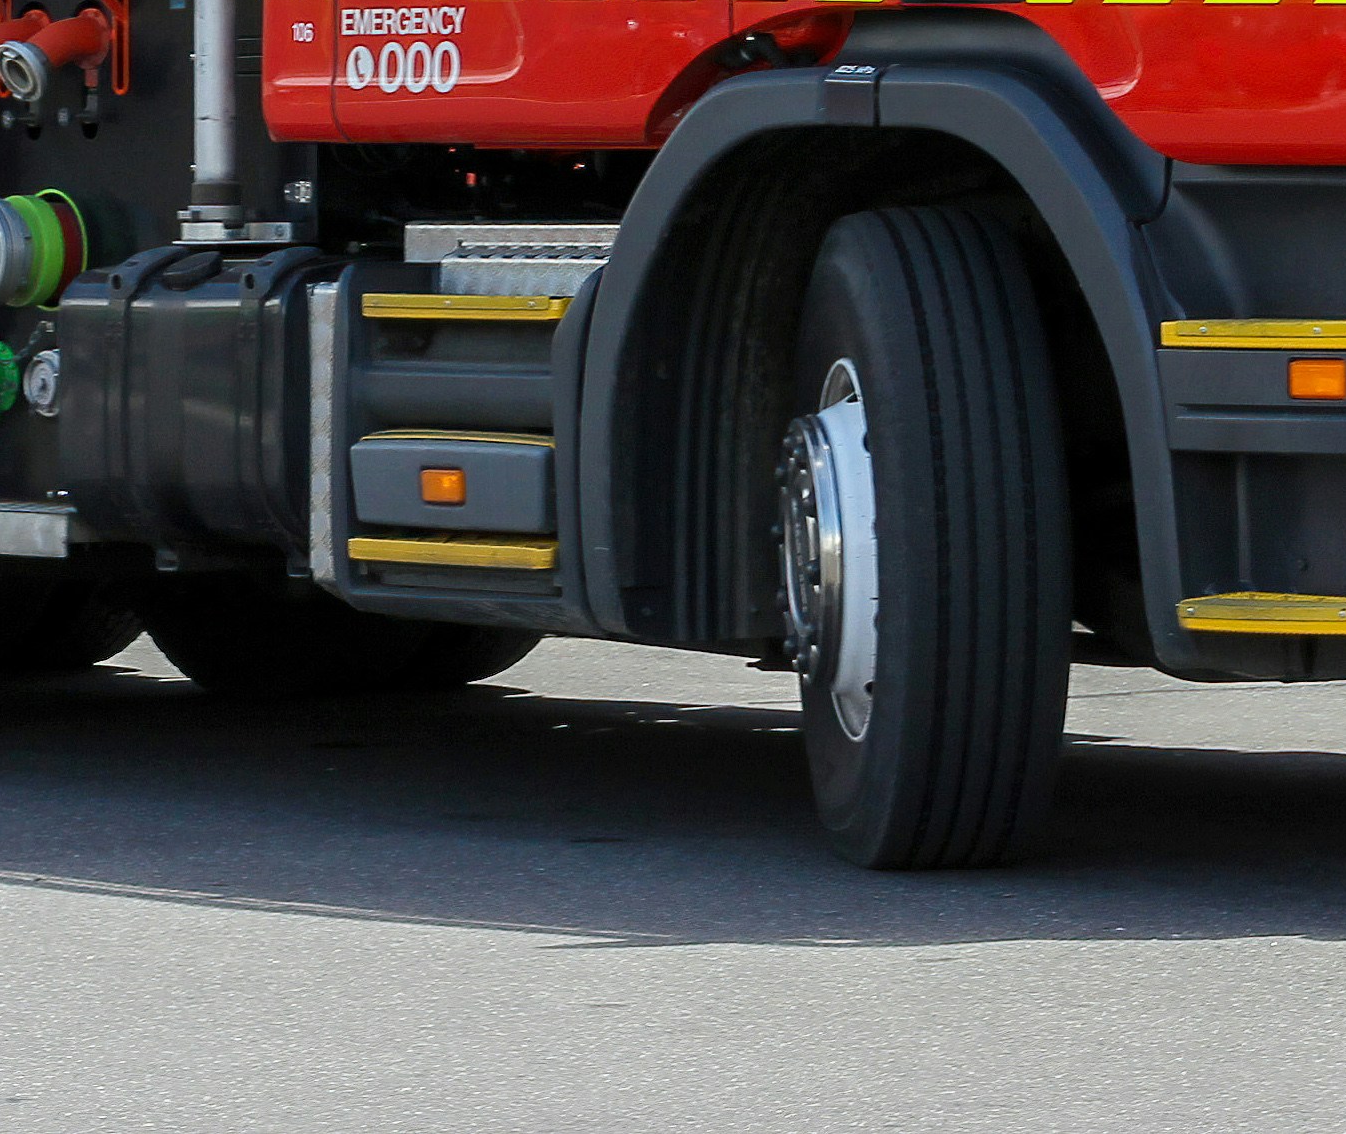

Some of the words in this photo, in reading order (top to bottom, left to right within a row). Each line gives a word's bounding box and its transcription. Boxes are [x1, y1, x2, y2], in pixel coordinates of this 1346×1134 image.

[291, 22, 315, 43] 106
[340, 6, 466, 36] EMERGENCY
[378, 40, 461, 94] 000
